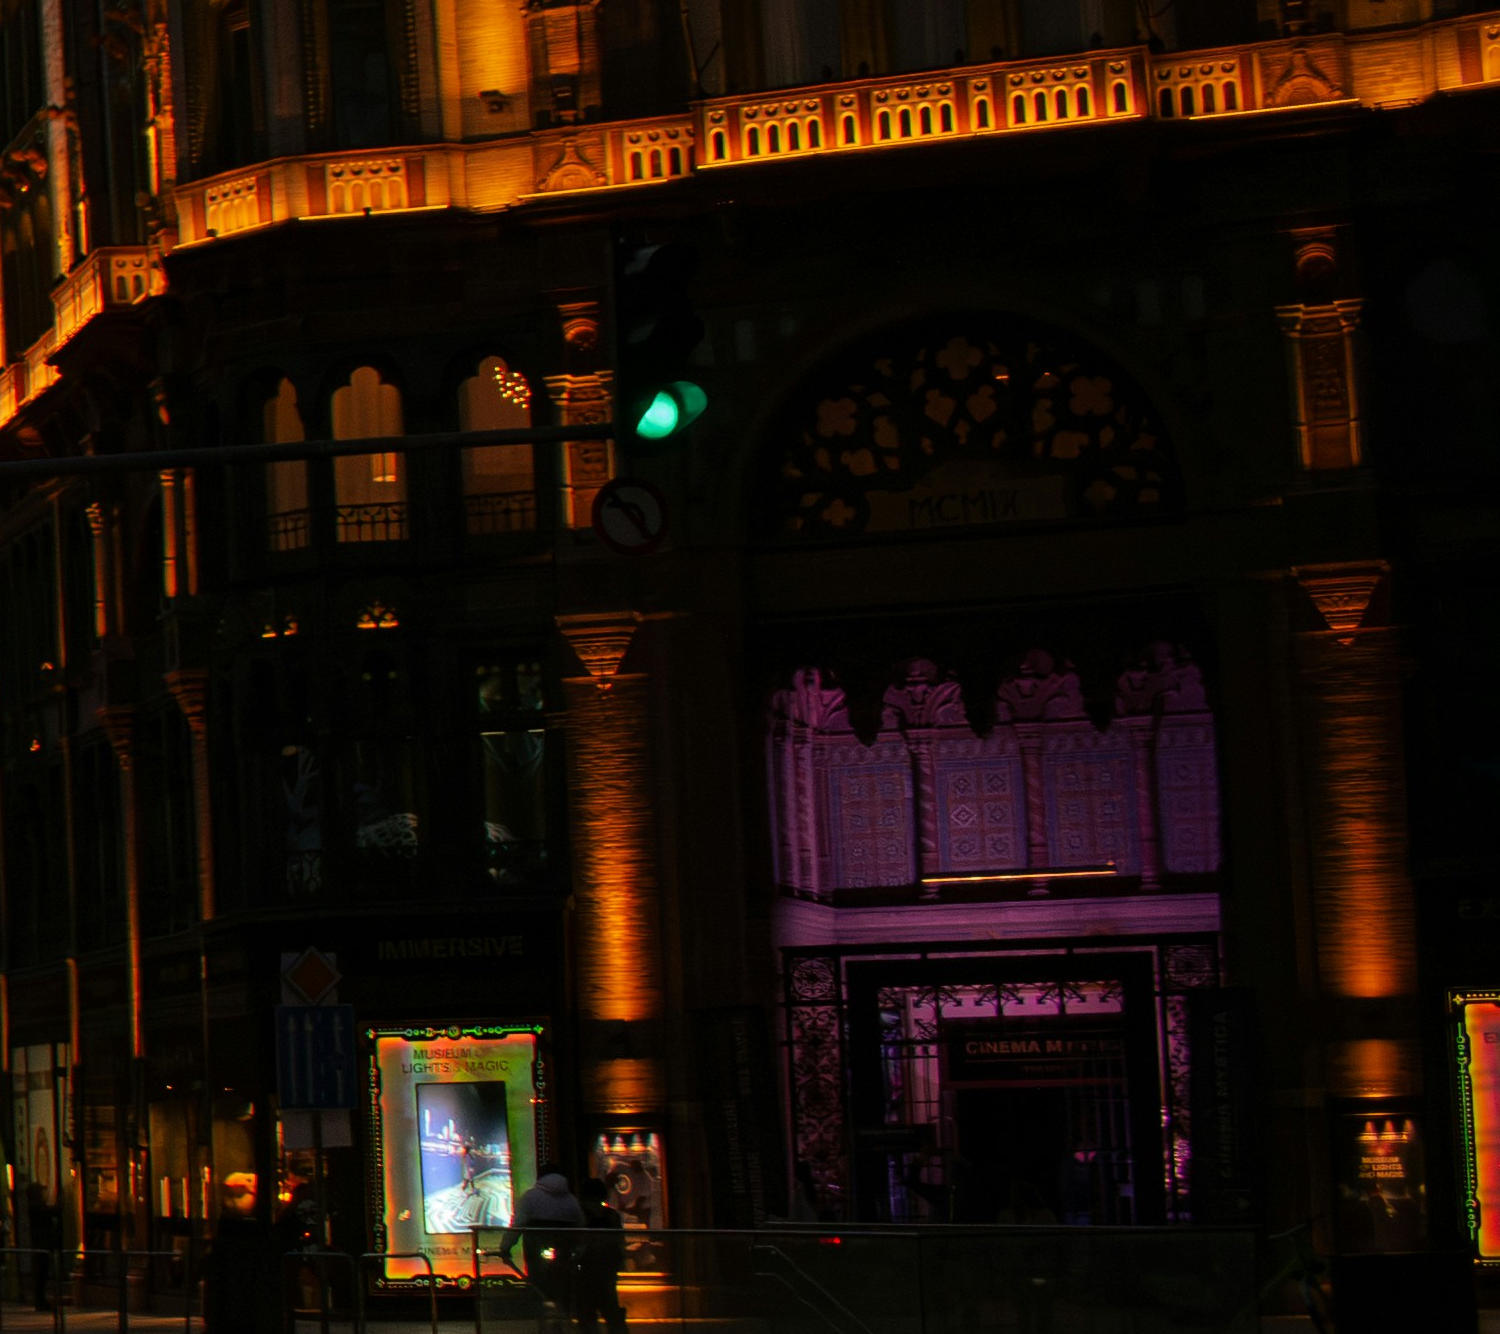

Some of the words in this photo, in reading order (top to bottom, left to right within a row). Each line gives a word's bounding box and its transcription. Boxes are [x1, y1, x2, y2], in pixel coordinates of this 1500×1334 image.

[378, 934, 524, 961] IMMERSIVE
[413, 1048, 471, 1059] MUSEUM
[964, 1040, 1041, 1055] CINEMA
[401, 1062, 449, 1073] LIGHTS
[465, 1060, 509, 1072] MAGIC
